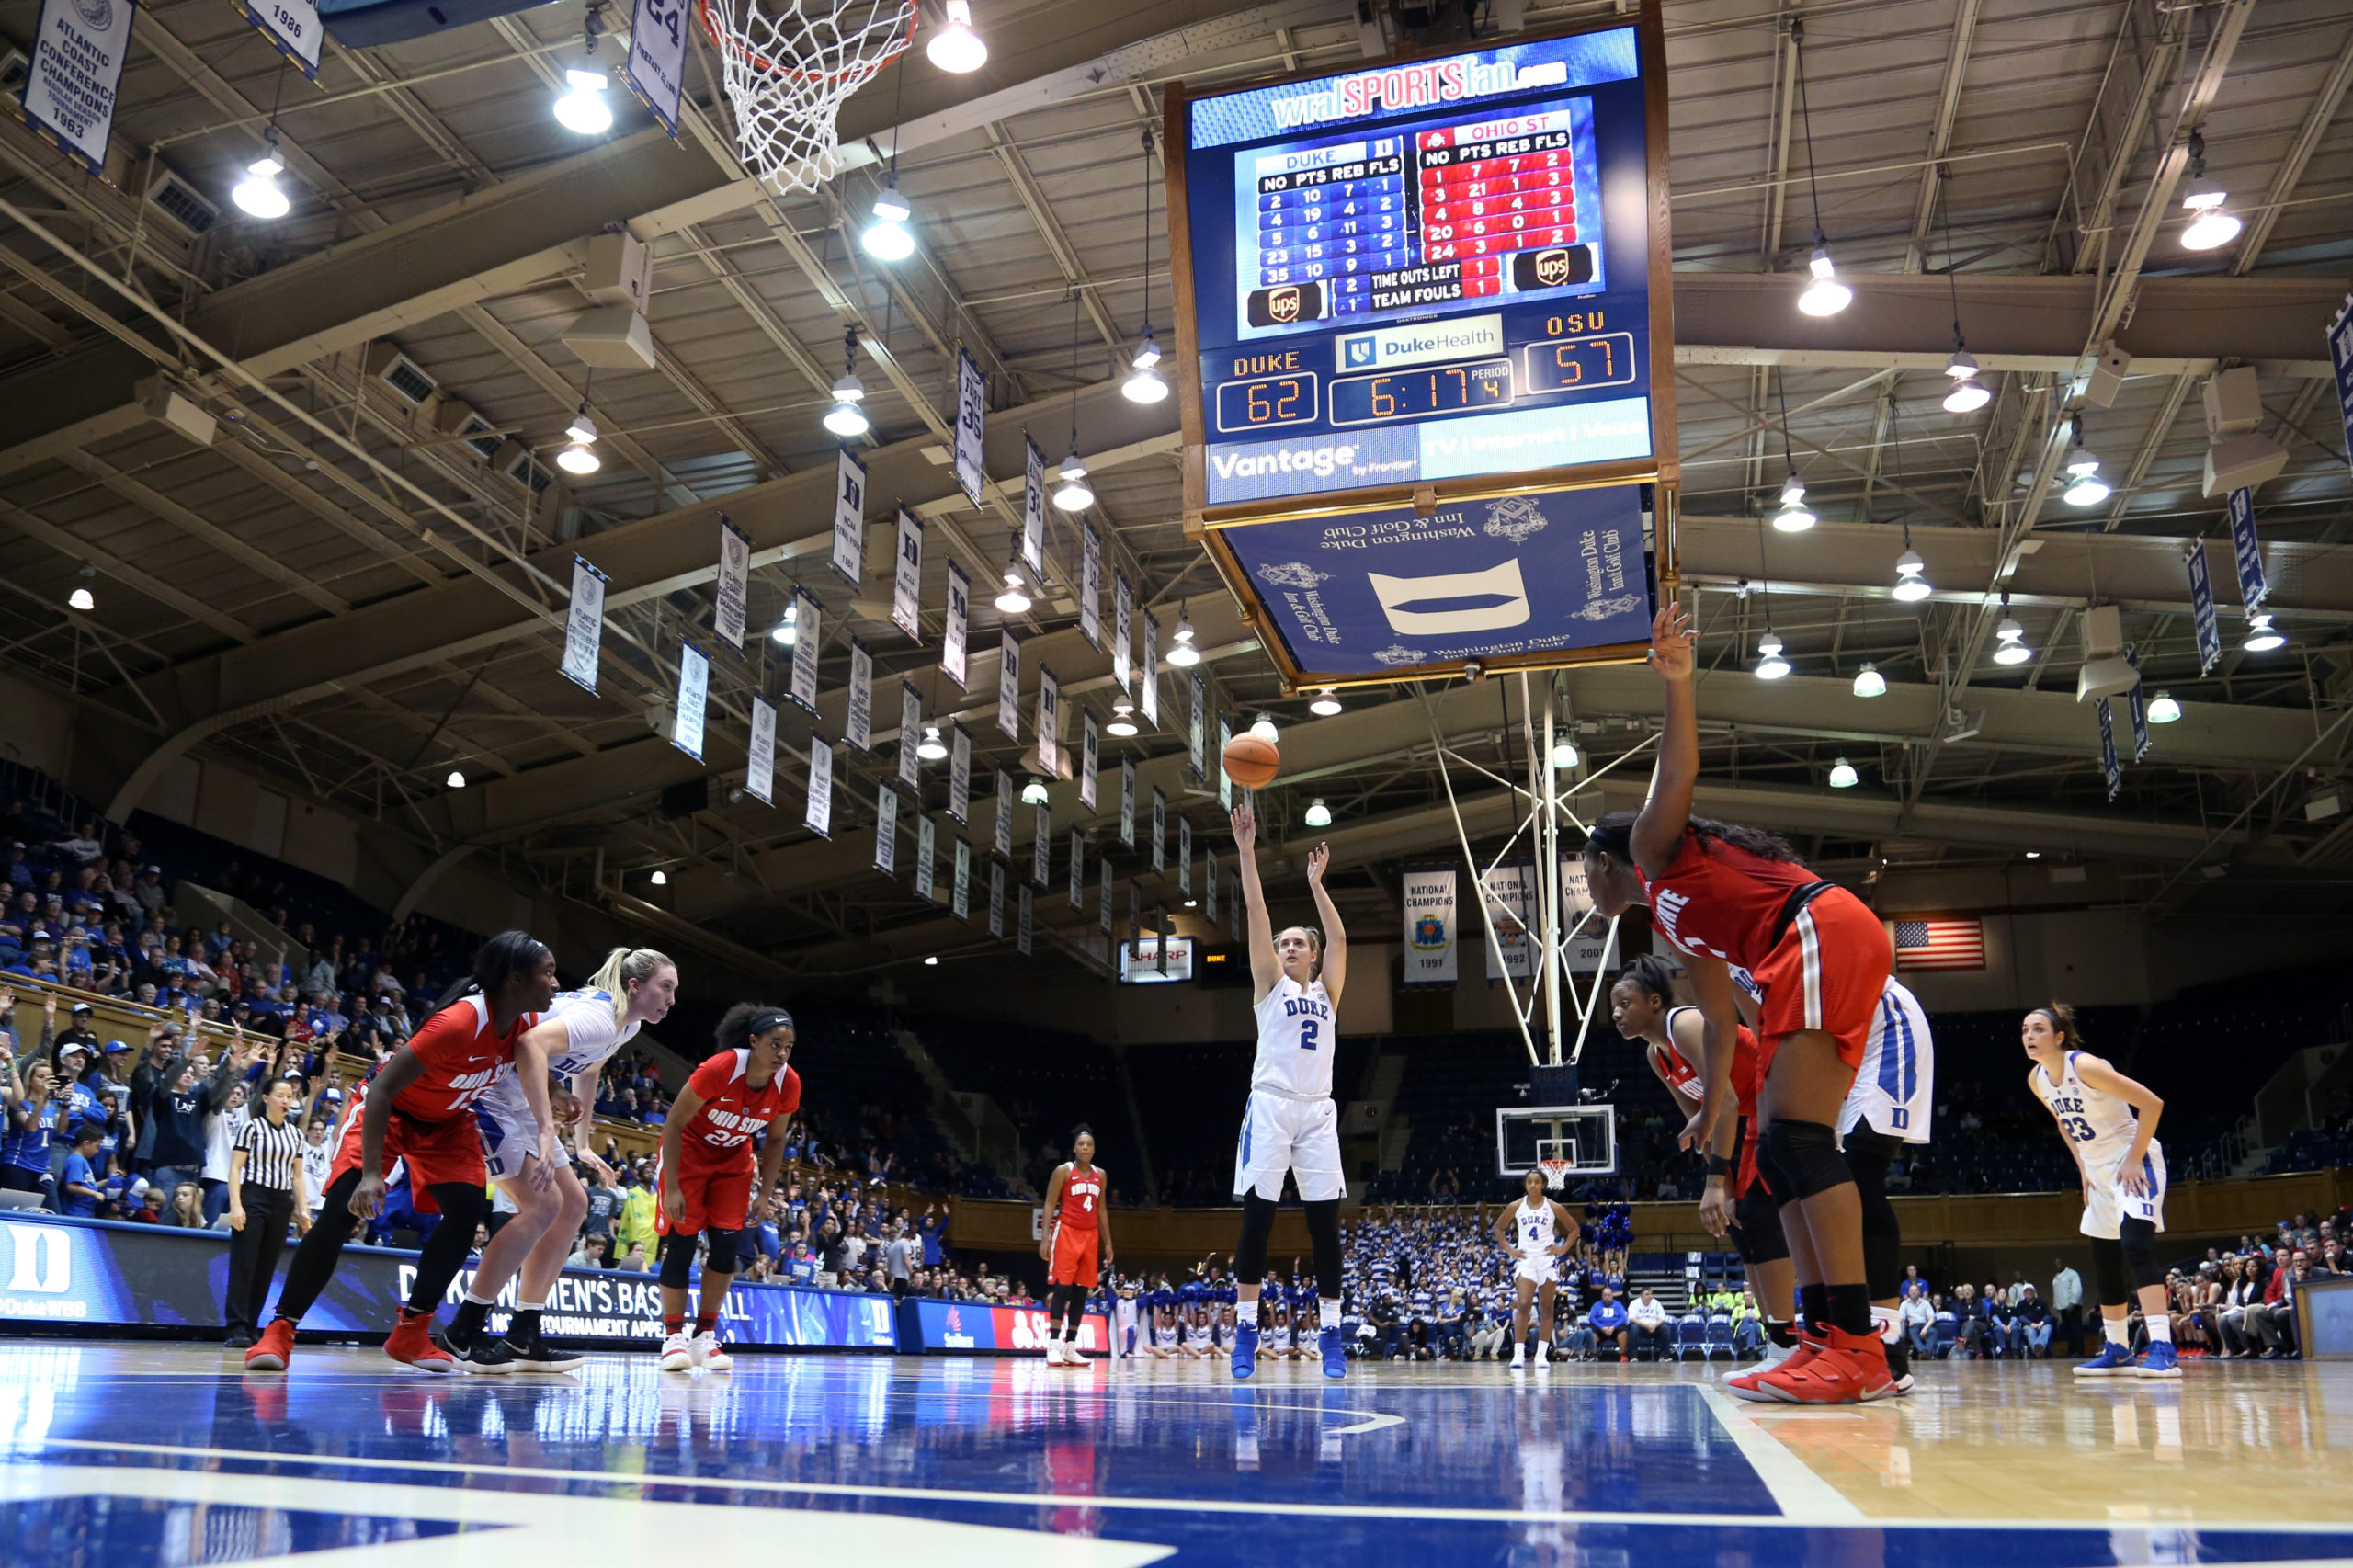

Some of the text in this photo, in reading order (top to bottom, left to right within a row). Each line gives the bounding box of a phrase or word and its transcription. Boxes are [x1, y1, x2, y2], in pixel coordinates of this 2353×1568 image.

[274, 5, 301, 38] 1986
[57, 18, 110, 67] ATLANTIC
[63, 40, 98, 75] COAST
[40, 40, 115, 105] CONFERENCE
[41, 58, 108, 118] CHAMPIONS
[43, 76, 101, 124] REGULAR SEASON
[48, 91, 94, 128] TOURNAMENT
[53, 108, 84, 138] 1963
[1472, 117, 1549, 140] OHIO ST
[1287, 151, 1336, 168] DUKE
[1427, 133, 1566, 165] NO PTS REB FLS
[1265, 158, 1399, 191] NO PTS REB FLS
[1436, 153, 1558, 183] 1 7 7 2
[1270, 178, 1388, 208] 2 10 7 1
[1435, 173, 1559, 201] 3 21 1 3
[1271, 198, 1391, 226] 4 19 4 2
[1435, 191, 1561, 220] 4 8 4 3
[1272, 216, 1392, 244] 5 6 11 3
[1430, 210, 1559, 240] 20 6 0 1
[1267, 234, 1392, 264] 23 15 3 2
[1431, 230, 1563, 259] 24 3 1 2
[1268, 254, 1391, 283] 35 10 9 1
[1347, 261, 1483, 291] 2 TIME OUTS LEFT 1
[1540, 261, 1565, 279] ups
[1272, 296, 1297, 315] ups
[1349, 281, 1484, 311] 1 TEAM FOULS 1
[1547, 311, 1604, 335] OSU
[1386, 329, 1494, 355] DukeHealth
[1234, 351, 1299, 377] DUKE
[1472, 366, 1508, 381] PERIOD
[1555, 340, 1612, 385] 57
[1248, 381, 1300, 422] 62
[1371, 369, 1467, 416] 6:17
[1484, 381, 1499, 398] 4
[1212, 444, 1356, 479] Vantage
[1320, 527, 1476, 550] Washington Duke
[1324, 513, 1464, 539] Inn & Golf Club
[1602, 529, 1620, 552] Club
[1579, 530, 1604, 599] Washington Duke
[1605, 552, 1621, 572] Golf
[1283, 592, 1298, 602] Inn
[1295, 611, 1315, 624] Golf
[1304, 590, 1341, 644] Washington Duke
[1303, 625, 1322, 641] Club
[1434, 634, 1570, 655] Washington Duke
[1406, 897, 1453, 907] CHAMPIONS
[1411, 885, 1449, 895] NATIONAL
[1419, 959, 1443, 969] 1991
[1284, 997, 1328, 1021] DUKE
[1301, 1019, 1318, 1051] 2
[448, 1068, 492, 1089] OHIO
[708, 1108, 740, 1129] OHIO
[1891, 1106, 1910, 1130] D
[2051, 1096, 2085, 1116] DUKE
[704, 1130, 748, 1147] 20
[2061, 1117, 2096, 1142] 23
[485, 1155, 505, 1176] D
[1083, 1195, 1093, 1212] 4
[2143, 1202, 2154, 1216] D
[1521, 1215, 1549, 1226] DUKE
[1528, 1226, 1539, 1241] 4
[7, 1224, 71, 1293] D
